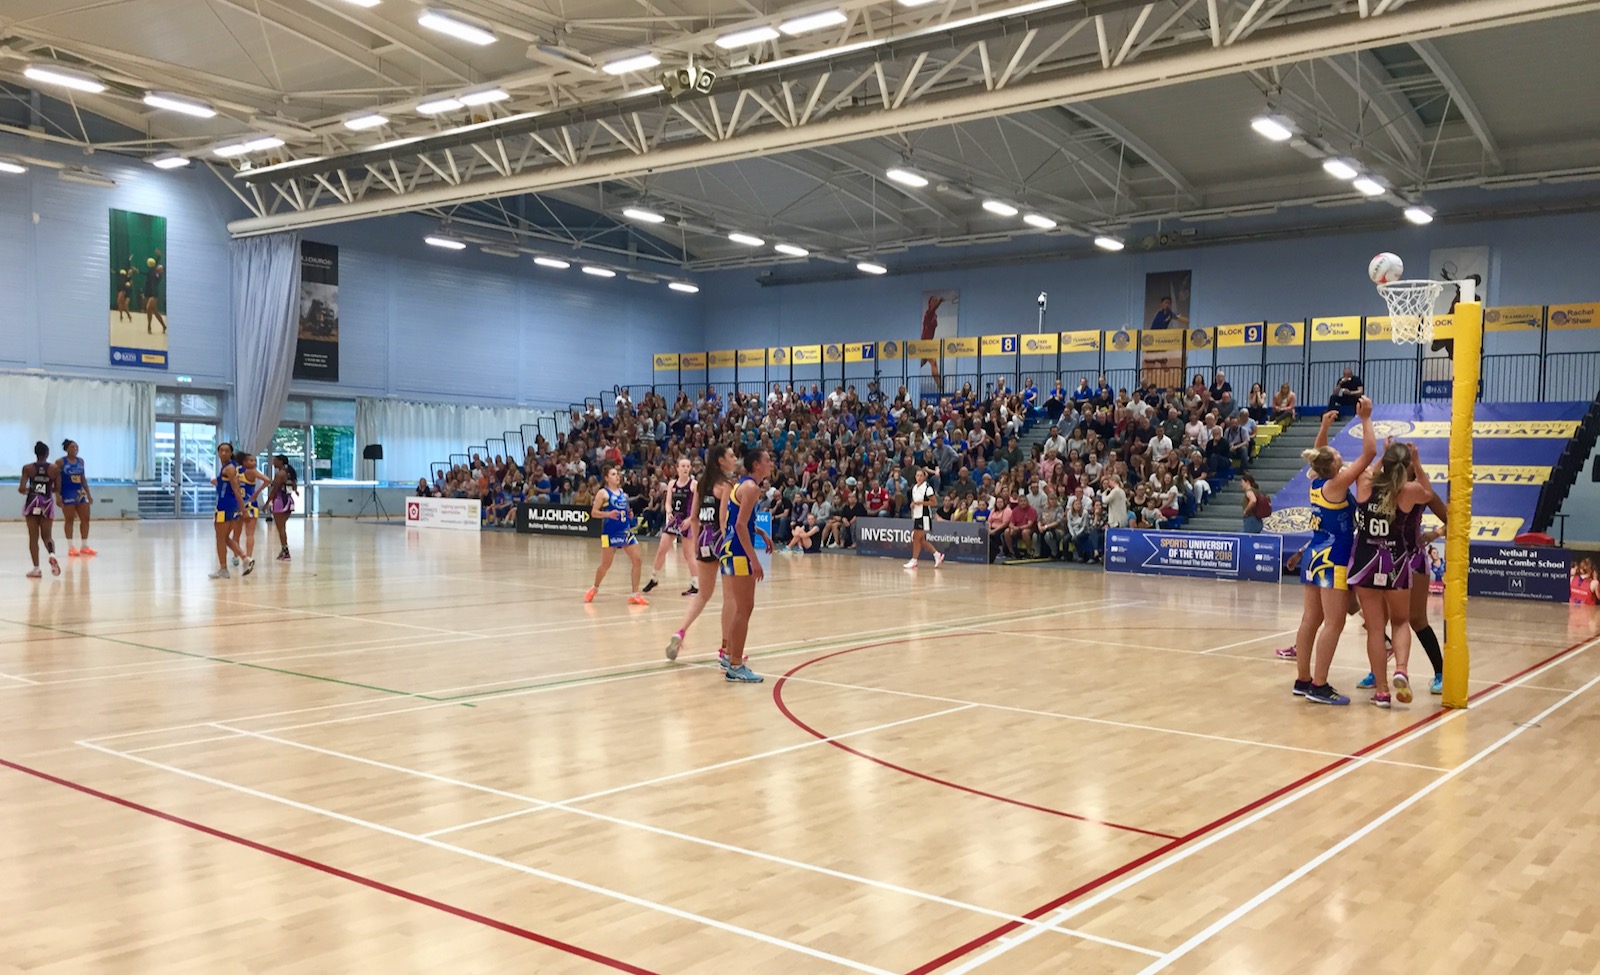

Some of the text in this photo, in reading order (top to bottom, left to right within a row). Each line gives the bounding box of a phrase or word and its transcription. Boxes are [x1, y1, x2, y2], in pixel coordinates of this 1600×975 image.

[1567, 308, 1594, 316] Rachel
[1248, 327, 1258, 341] 9
[1004, 338, 1012, 351] 8
[864, 345, 871, 358] 7
[528, 508, 585, 523] M.J.CHURCH
[699, 507, 716, 521] WR
[528, 522, 544, 530] Building
[1369, 518, 1390, 537] GD
[926, 532, 959, 544] Recruiting
[961, 535, 984, 545] talent.
[1160, 538, 1234, 551] SPORTS UNIVERSITY
[1168, 548, 1233, 561] OF THE YEAR 2018
[1499, 548, 1538, 558] Netball at
[1169, 557, 1182, 565] Times
[1183, 558, 1192, 566] and
[1200, 559, 1217, 568] Sunday
[1217, 560, 1232, 568] Times
[1472, 556, 1565, 569] Monkton Combe School
[1468, 566, 1568, 580] Developing excellence in sport
[1511, 579, 1522, 588] M
